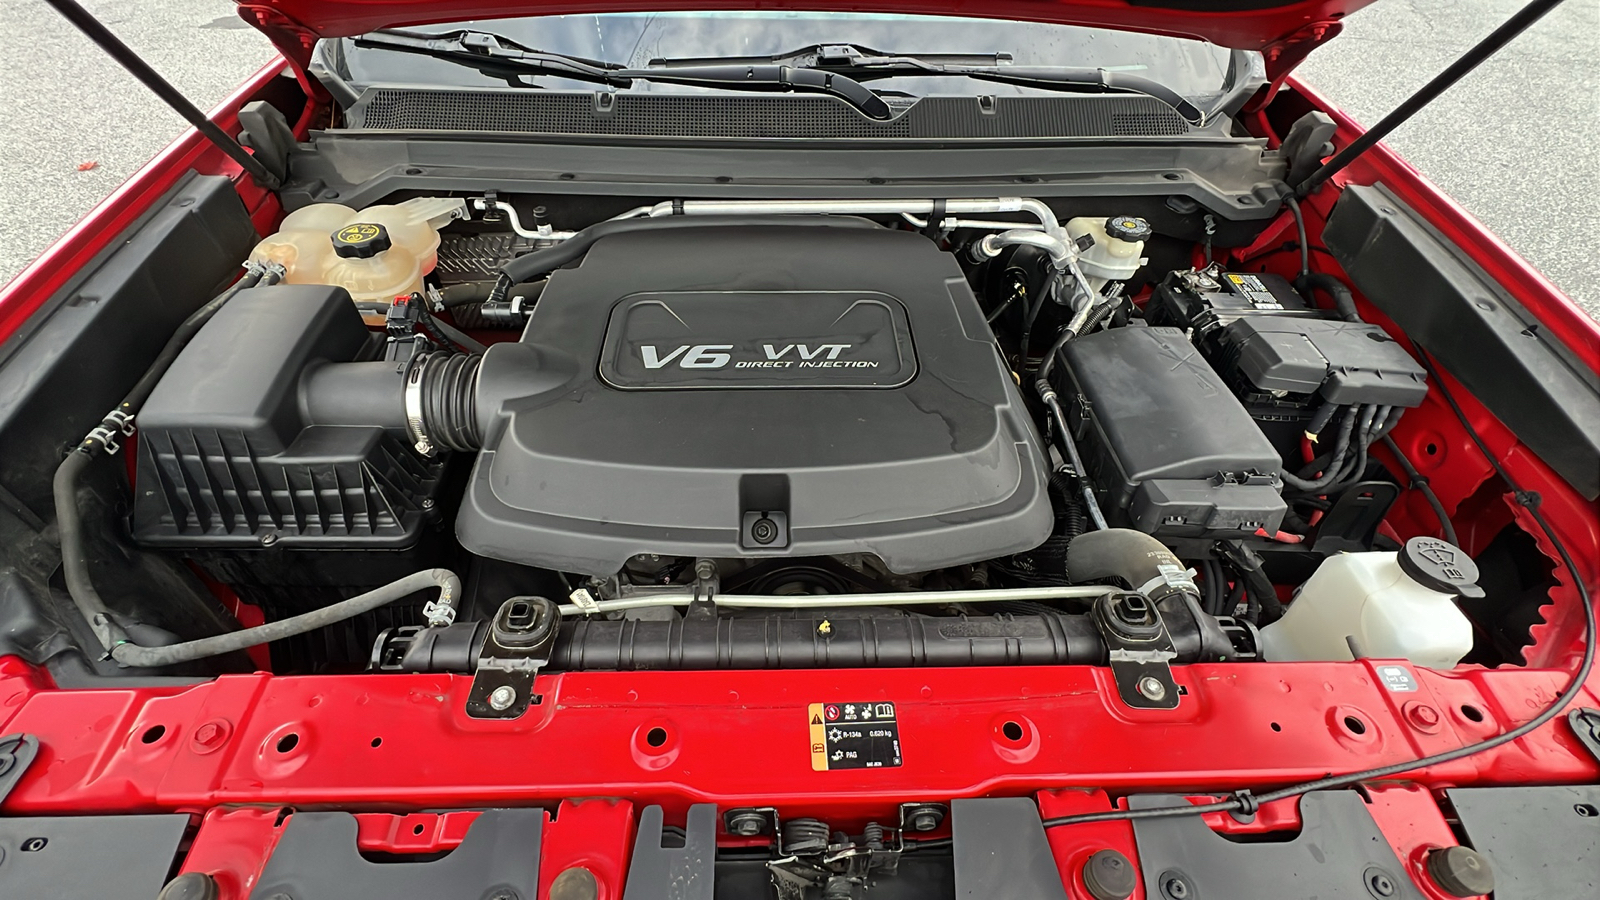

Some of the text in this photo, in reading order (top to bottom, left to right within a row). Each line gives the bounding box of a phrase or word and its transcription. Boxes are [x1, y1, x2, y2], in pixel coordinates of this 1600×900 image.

[640, 344, 851, 369] V6 VVT
[885, 729, 892, 737] kg
